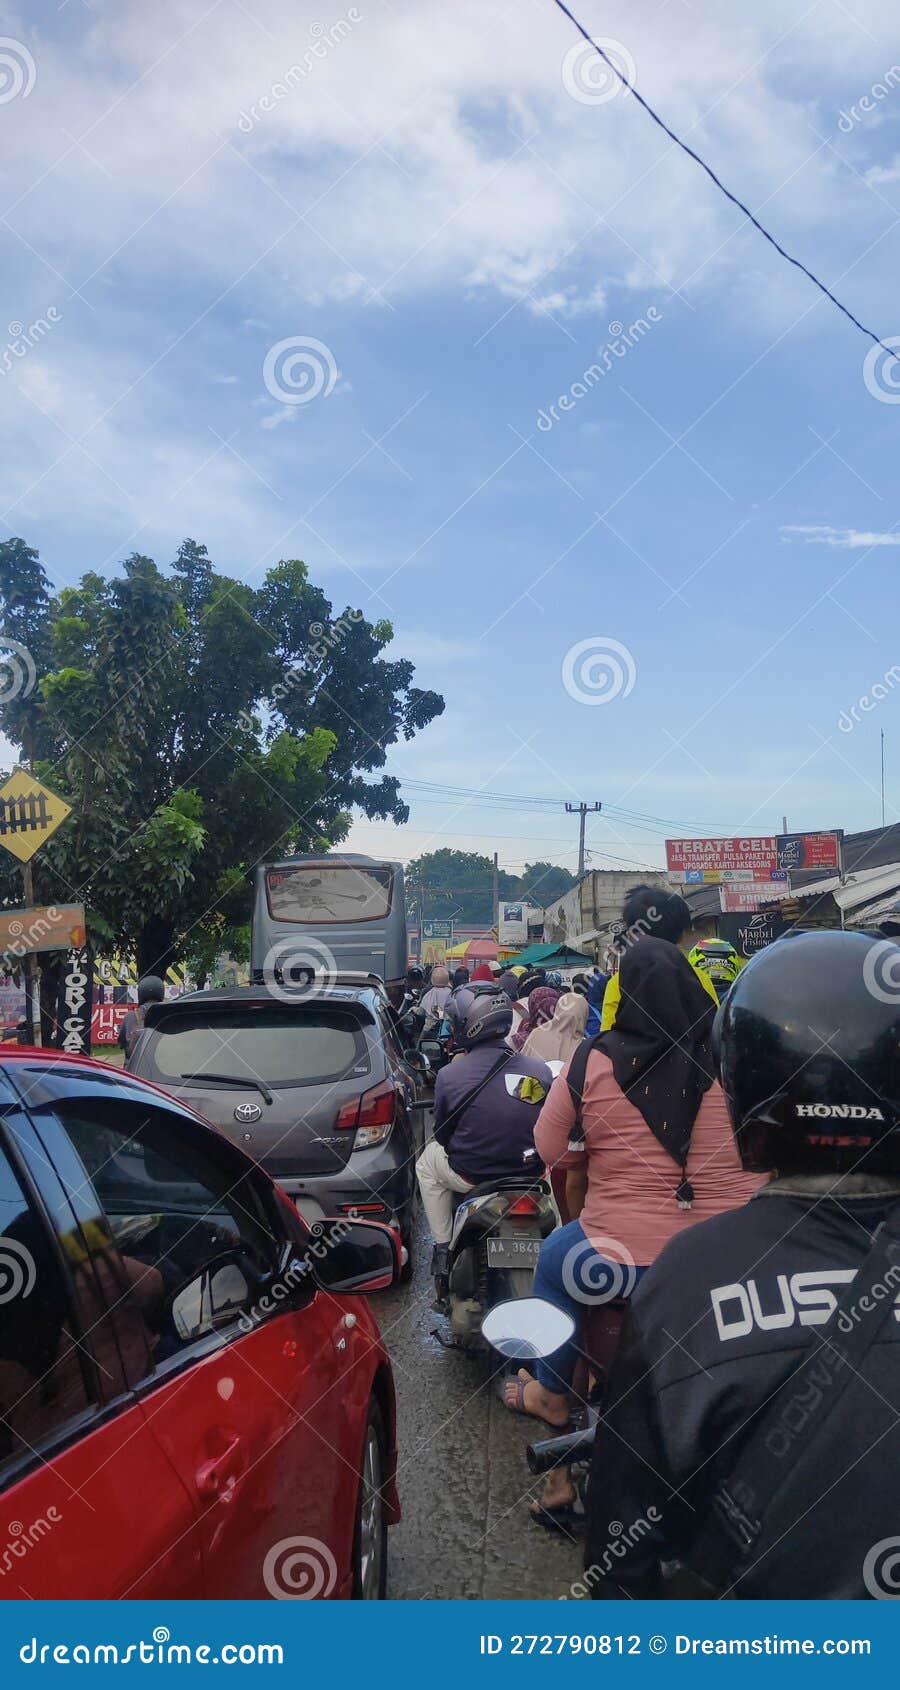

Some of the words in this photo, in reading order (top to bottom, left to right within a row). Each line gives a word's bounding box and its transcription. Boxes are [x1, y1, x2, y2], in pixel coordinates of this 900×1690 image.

[671, 840, 734, 853] TERATE
[671, 854, 687, 862] JASA
[687, 853, 720, 862] TRANSFER
[723, 853, 744, 861] PULSA
[745, 852, 765, 861] PAKET
[683, 862, 713, 870] UPGRADE
[714, 861, 735, 870] KARTU
[736, 860, 771, 869] AKSESORIS
[795, 1103, 885, 1121] HONDA
[490, 1241, 505, 1254] AA
